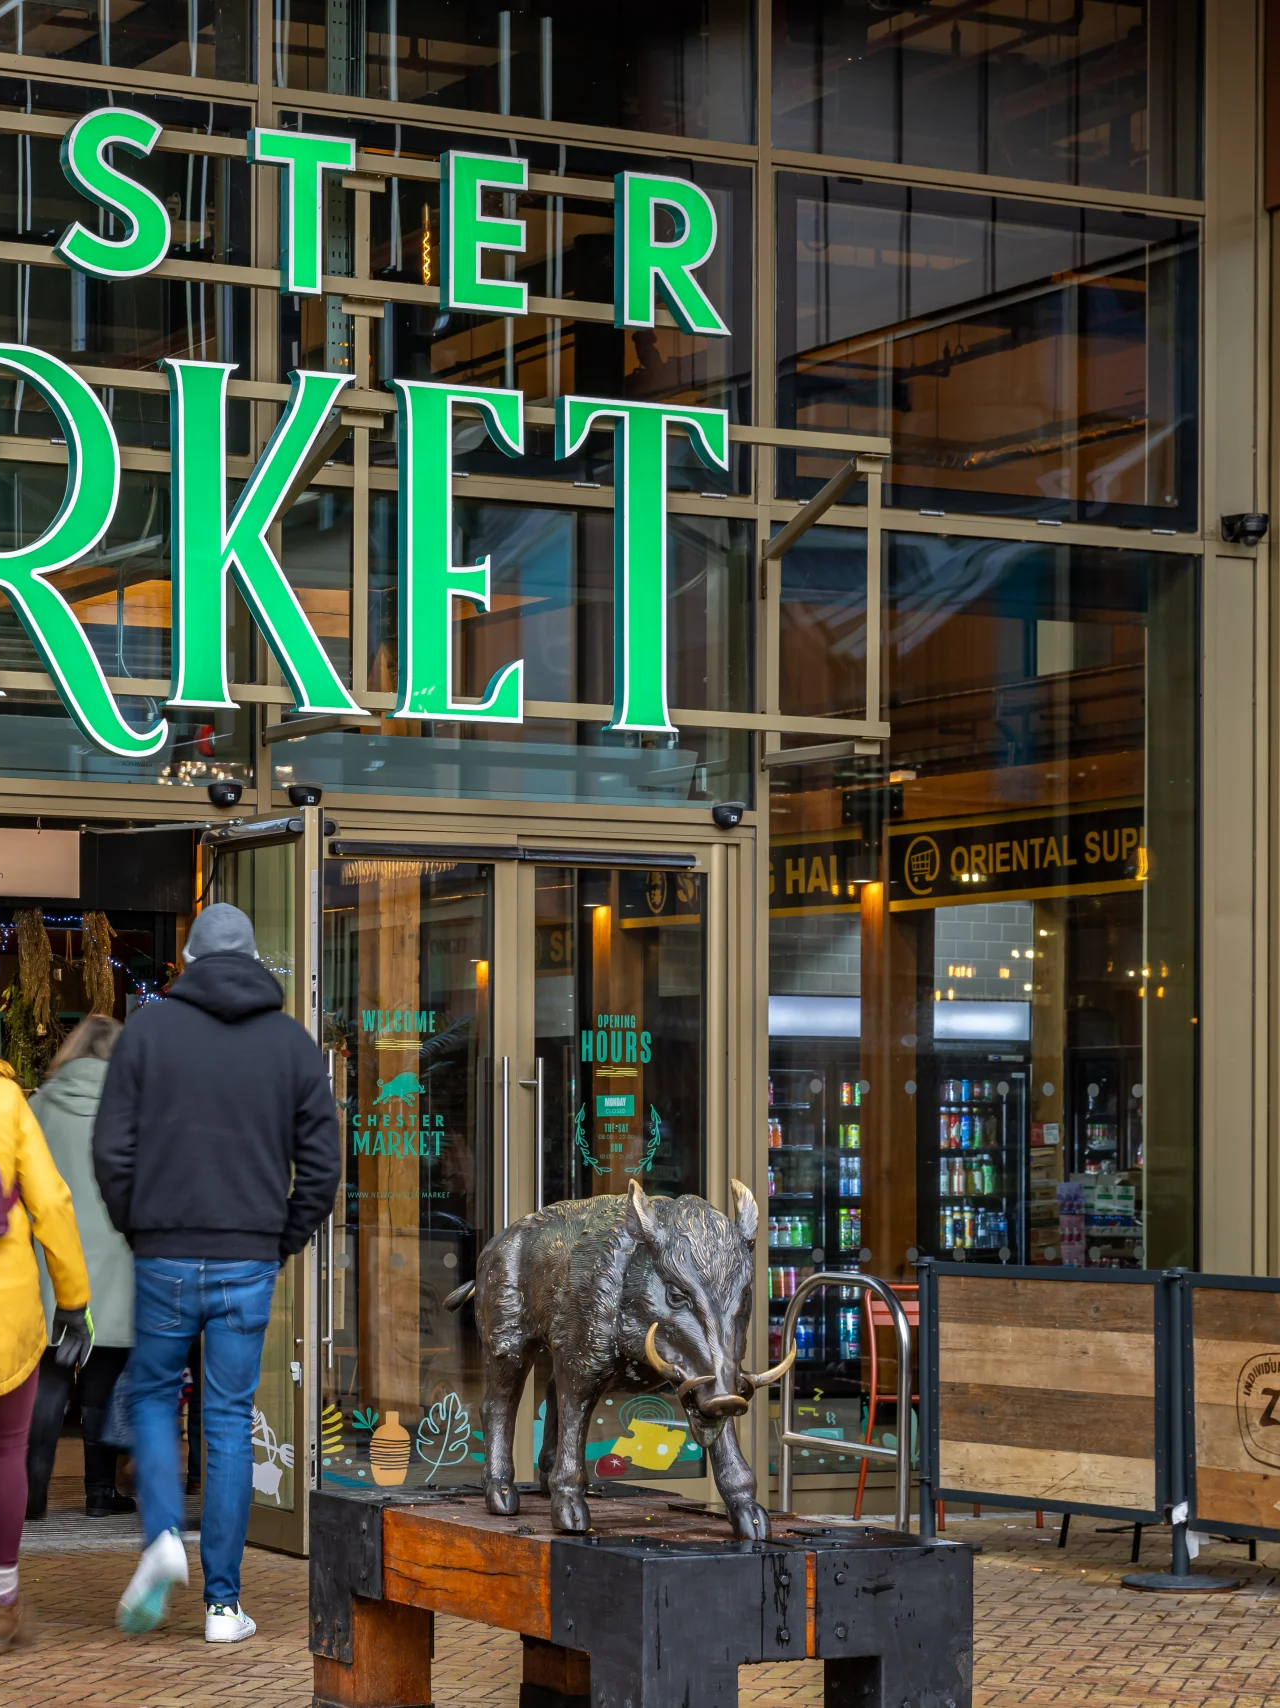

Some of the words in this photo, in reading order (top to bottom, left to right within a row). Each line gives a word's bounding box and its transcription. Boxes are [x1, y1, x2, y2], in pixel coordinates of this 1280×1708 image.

[950, 836, 1077, 878] ORIENTAL
[785, 855, 838, 895] HAI
[362, 1009, 436, 1033] WELCOME
[597, 1014, 636, 1028] OPENING
[581, 1030, 652, 1063] HOURS
[604, 1097, 627, 1107] MONDAY
[352, 1114, 445, 1127] CHESTER
[352, 1130, 445, 1159] MARKET
[610, 1143, 623, 1153] SUN
